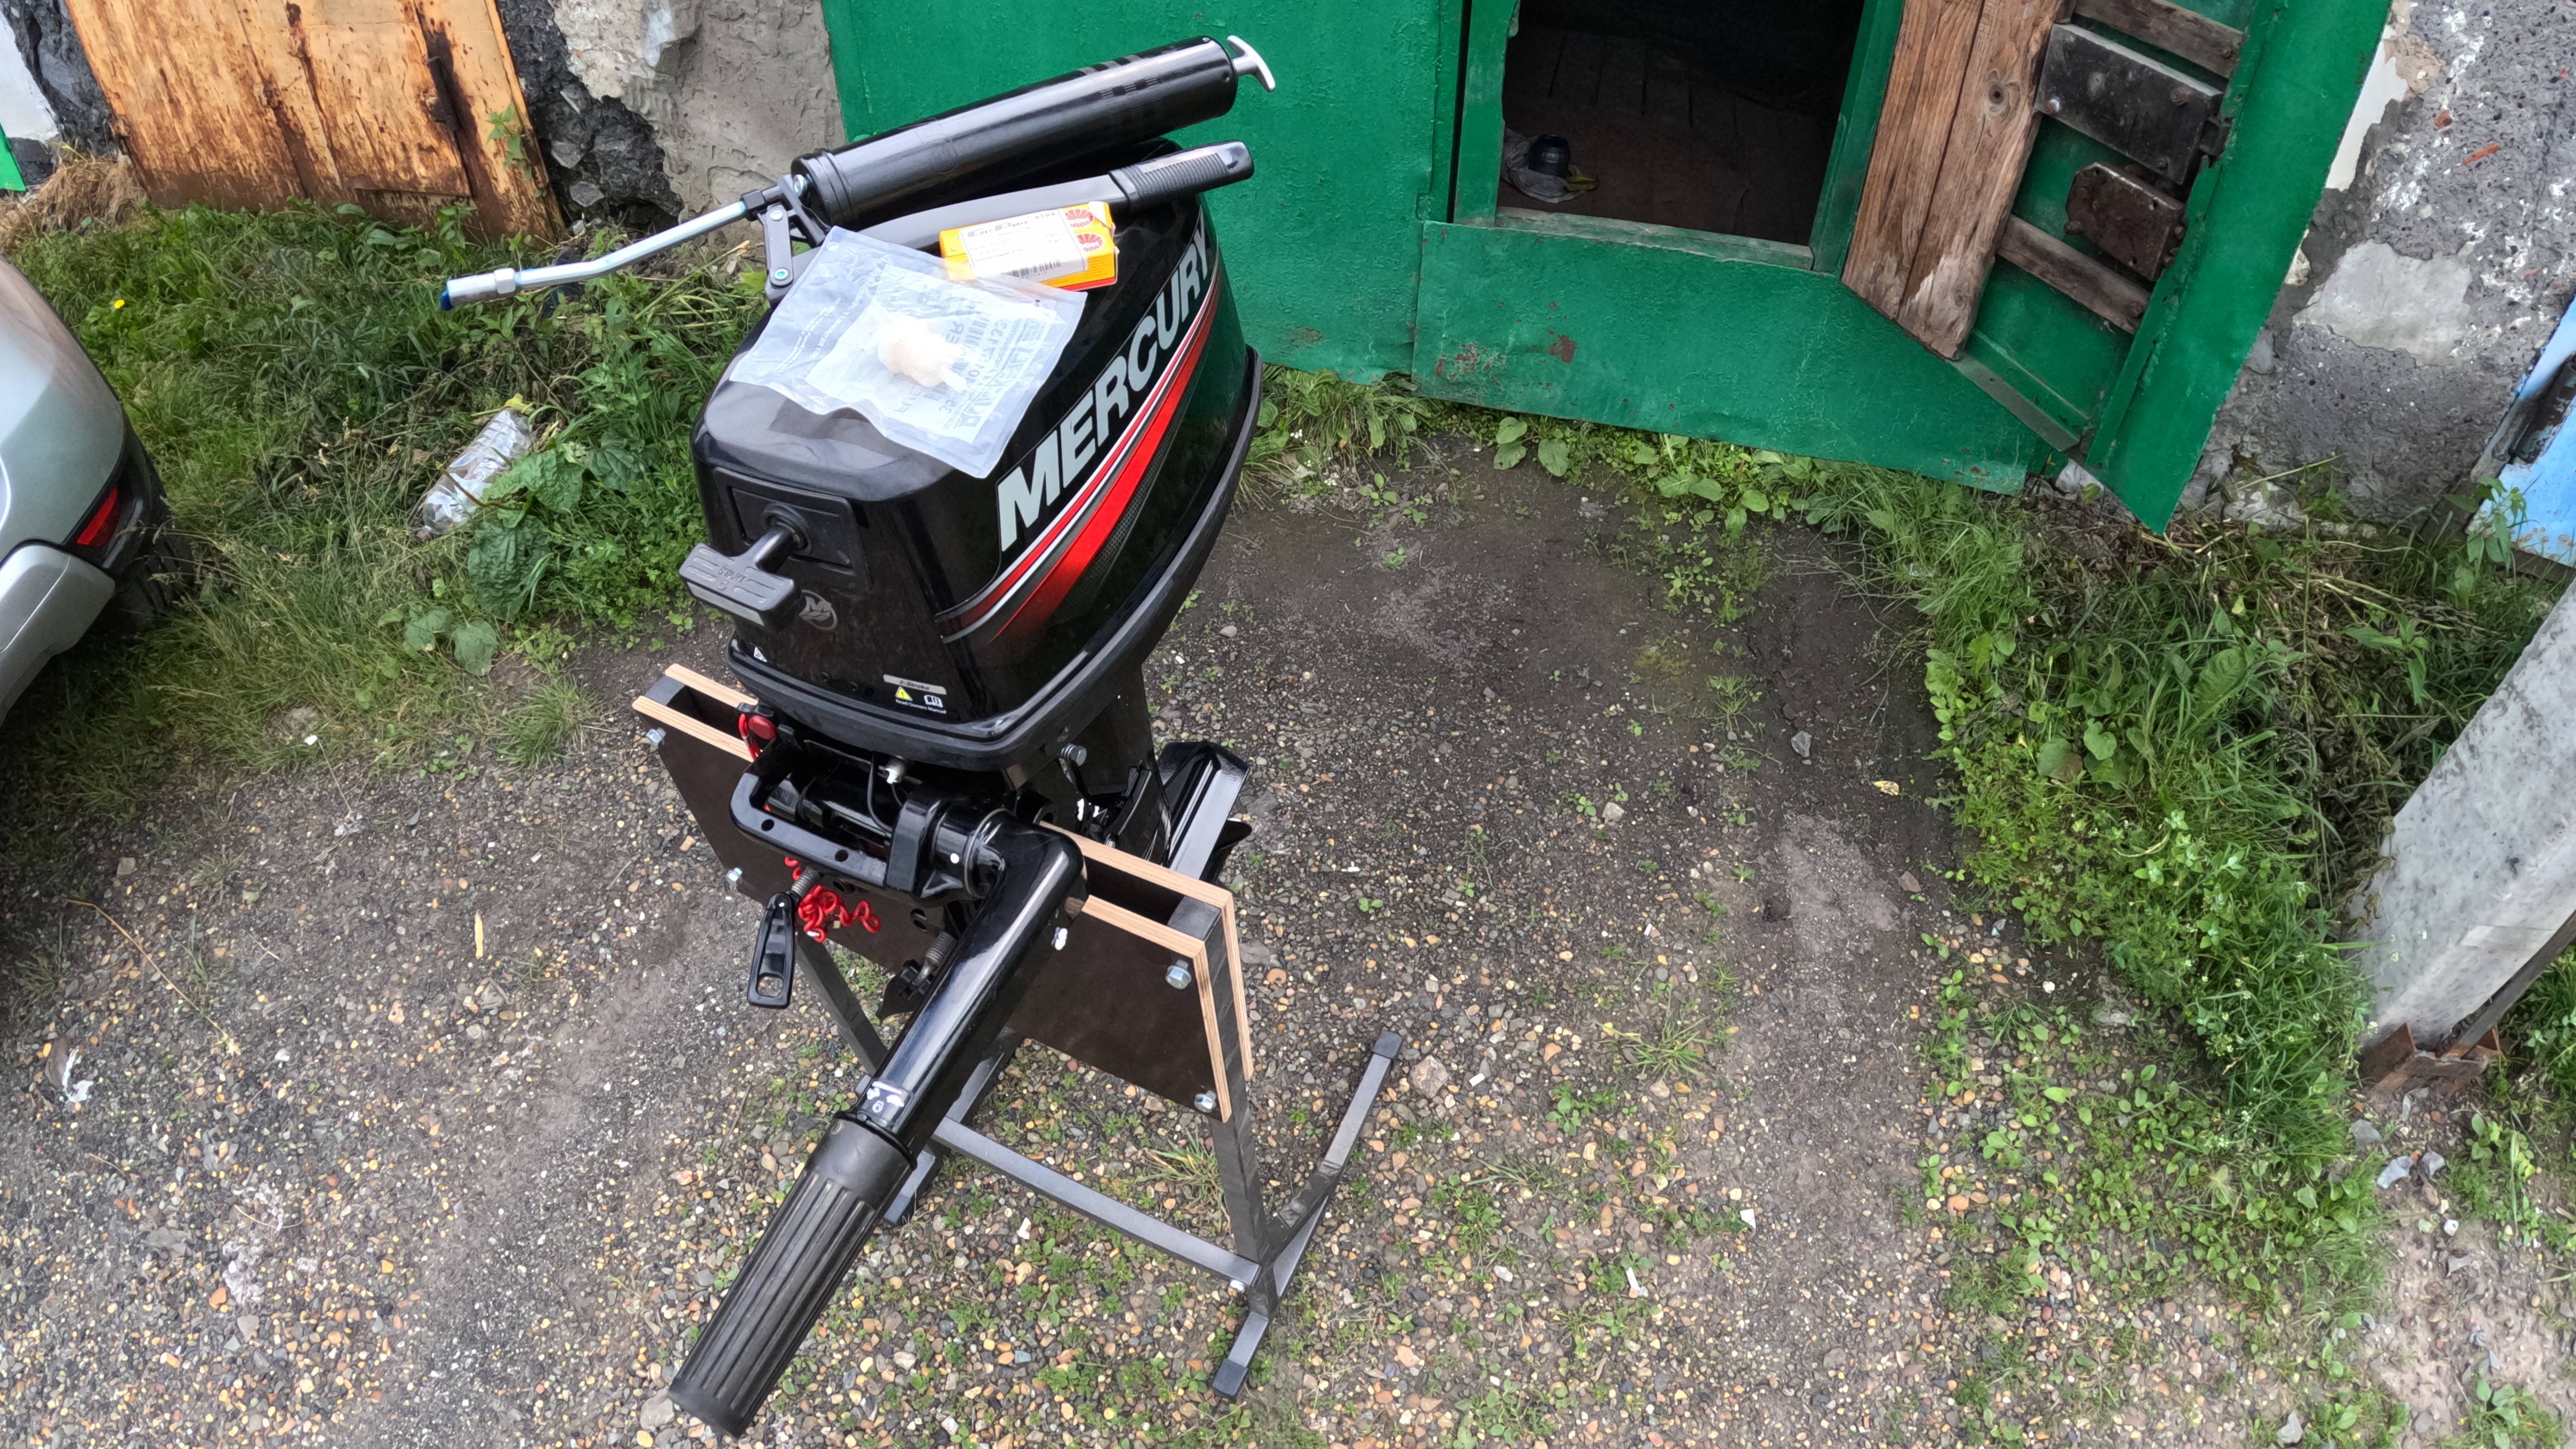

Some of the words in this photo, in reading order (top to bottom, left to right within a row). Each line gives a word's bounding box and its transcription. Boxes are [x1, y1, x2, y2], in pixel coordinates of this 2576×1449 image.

[997, 208, 1208, 551] MERCURY
[718, 566, 748, 583] START
[899, 680, 930, 691] 2-Stroke
